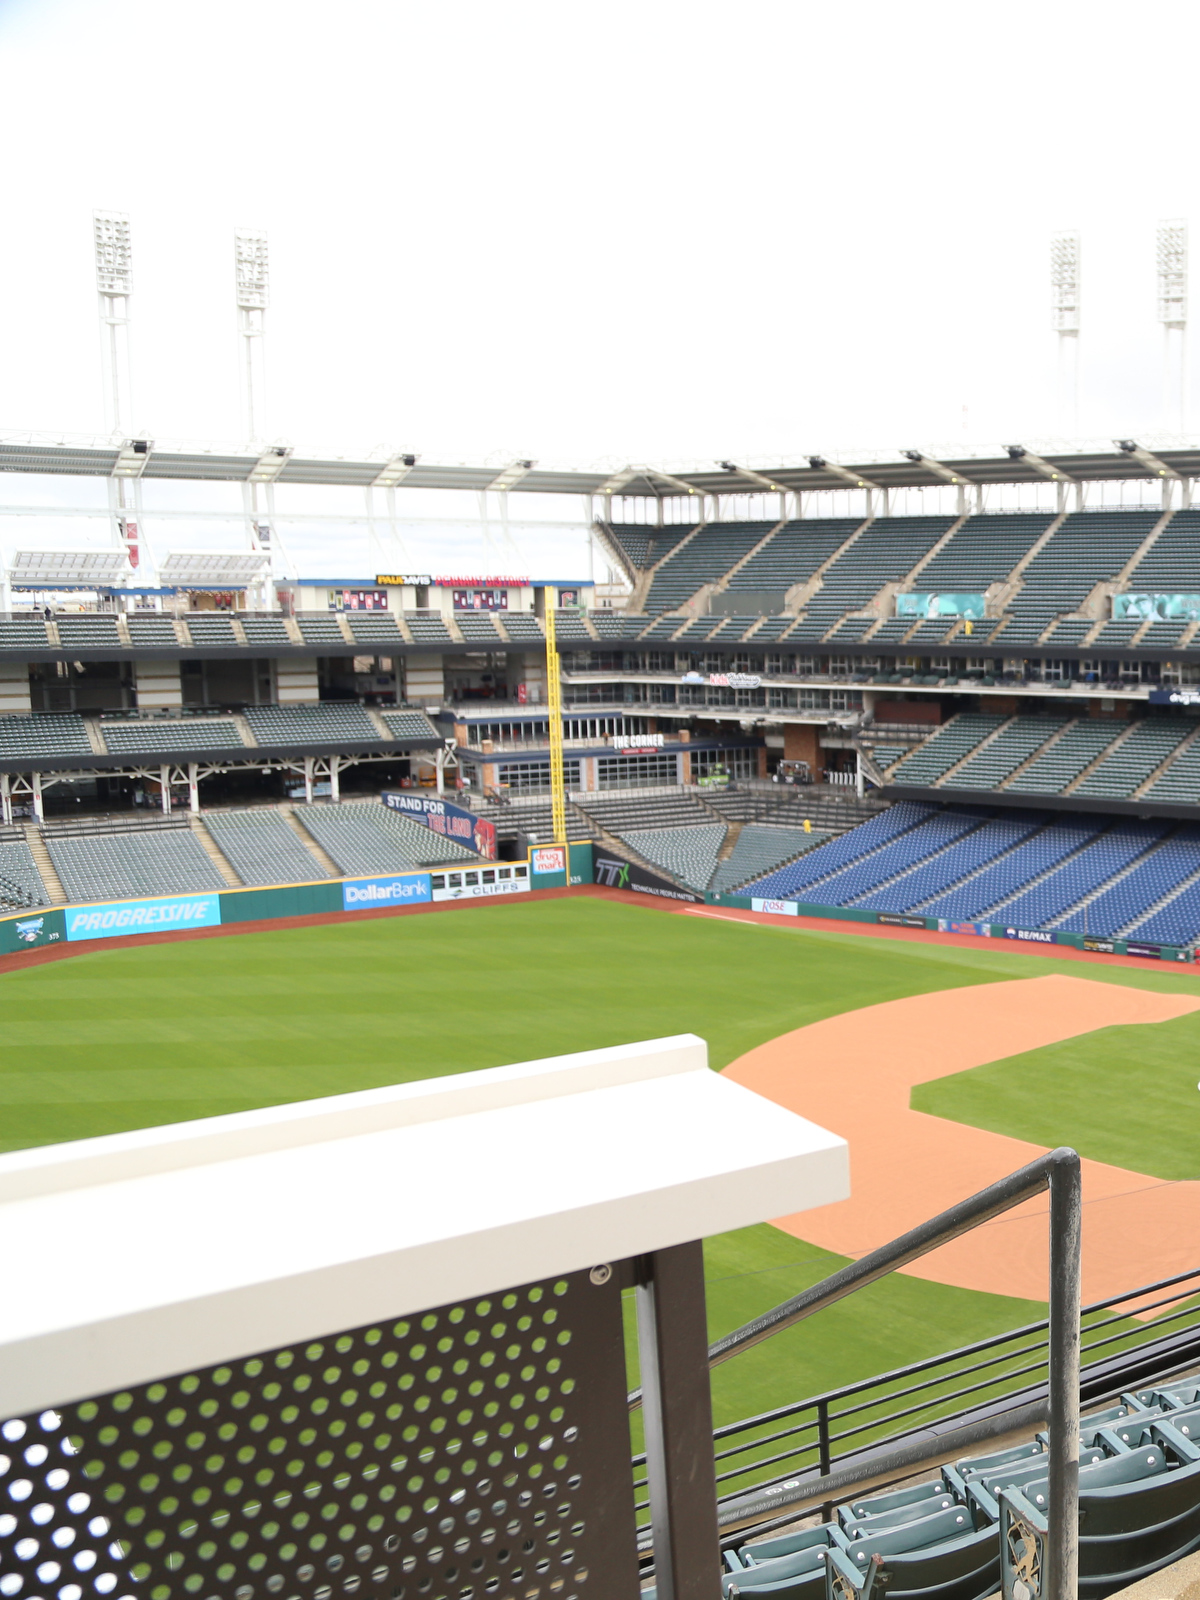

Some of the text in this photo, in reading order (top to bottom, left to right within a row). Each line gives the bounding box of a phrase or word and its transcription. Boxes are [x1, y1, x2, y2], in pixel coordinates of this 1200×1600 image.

[1169, 693, 1190, 705] drug
[612, 734, 664, 749] THE CORNER
[387, 794, 446, 815] STAND FOR
[427, 813, 472, 839] THE LAND
[535, 849, 559, 862] drug
[537, 860, 565, 871] mart
[472, 883, 519, 896] CLIFFS
[762, 900, 785, 912] ROSE
[71, 901, 210, 932] PROGRESSIVE
[1018, 930, 1052, 943] RE/MAX
